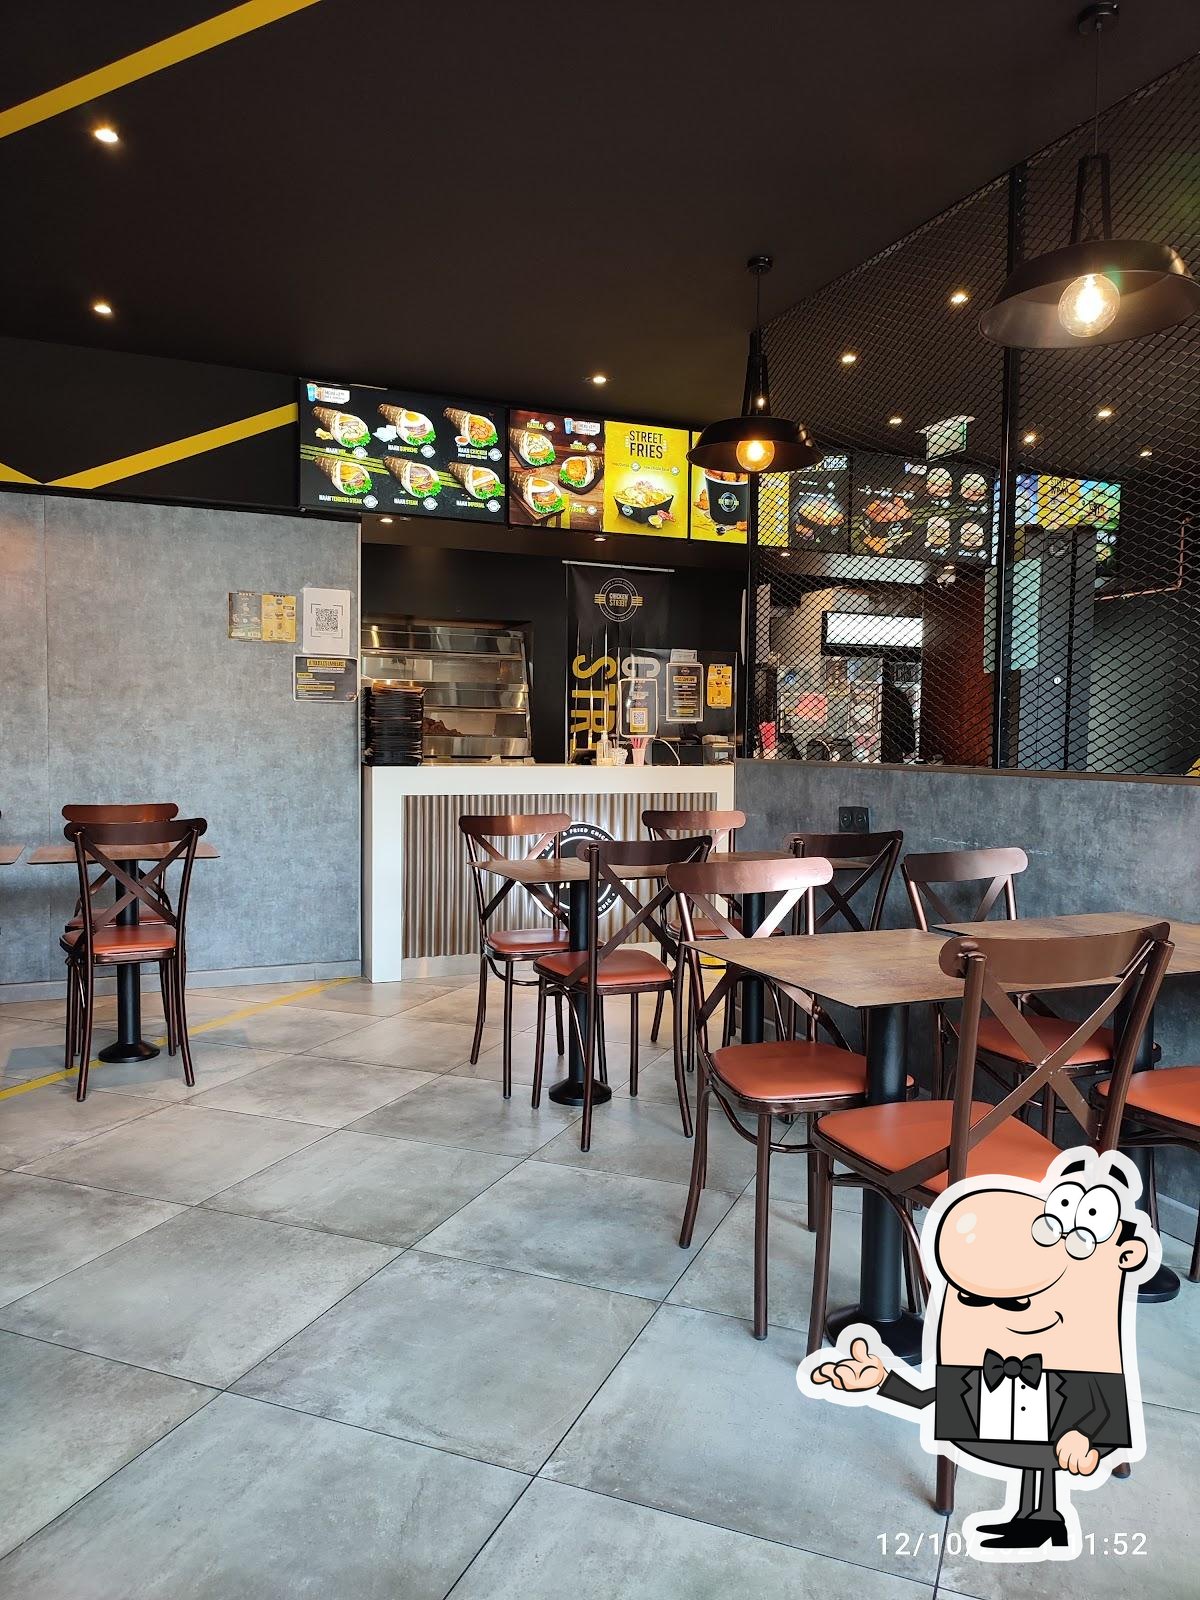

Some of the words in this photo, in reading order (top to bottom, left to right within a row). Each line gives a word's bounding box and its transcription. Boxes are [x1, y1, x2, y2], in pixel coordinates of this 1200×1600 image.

[629, 430, 664, 445] STREET
[629, 442, 664, 459] FRIES
[608, 598, 628, 607] STREET
